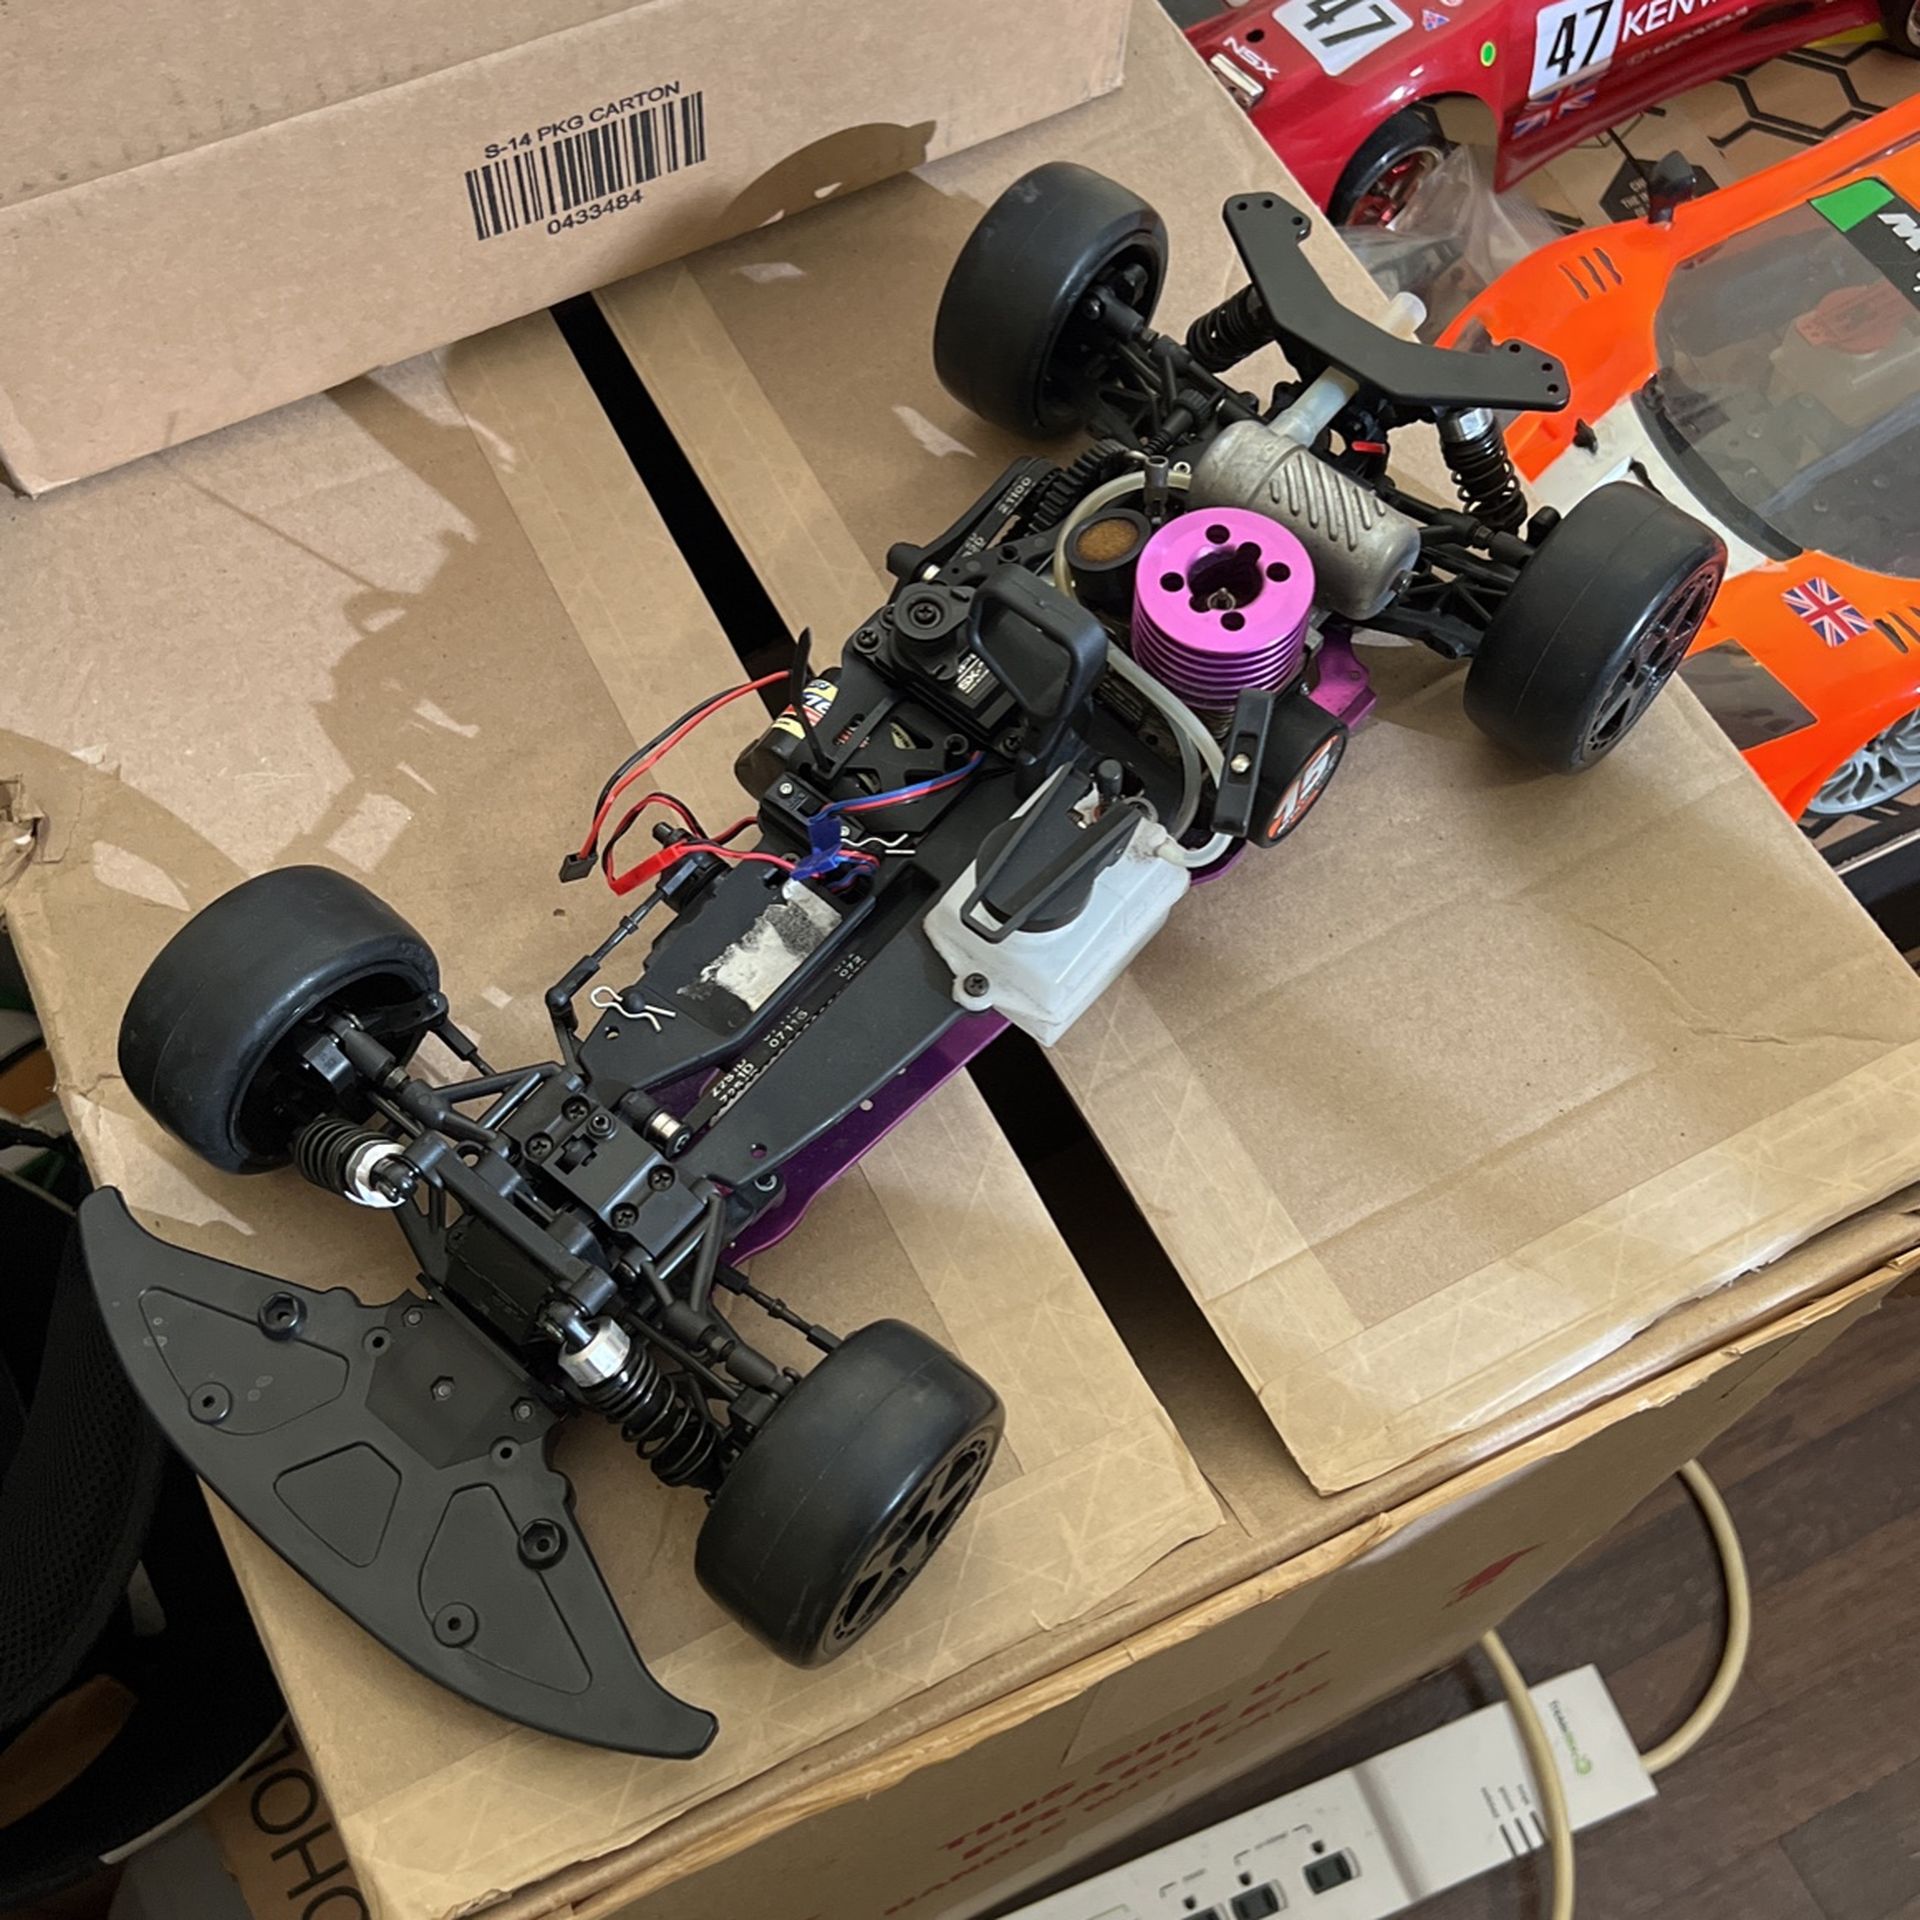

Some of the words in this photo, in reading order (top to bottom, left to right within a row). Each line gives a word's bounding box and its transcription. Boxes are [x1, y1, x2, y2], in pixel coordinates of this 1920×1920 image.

[1545, 0, 1613, 77] 47
[1622, 0, 1717, 42] KEN
[1222, 36, 1280, 80] NSX
[485, 133, 532, 159] S-14
[537, 116, 584, 141] PKG
[589, 80, 680, 123] CARTON
[547, 189, 643, 235] 0433484
